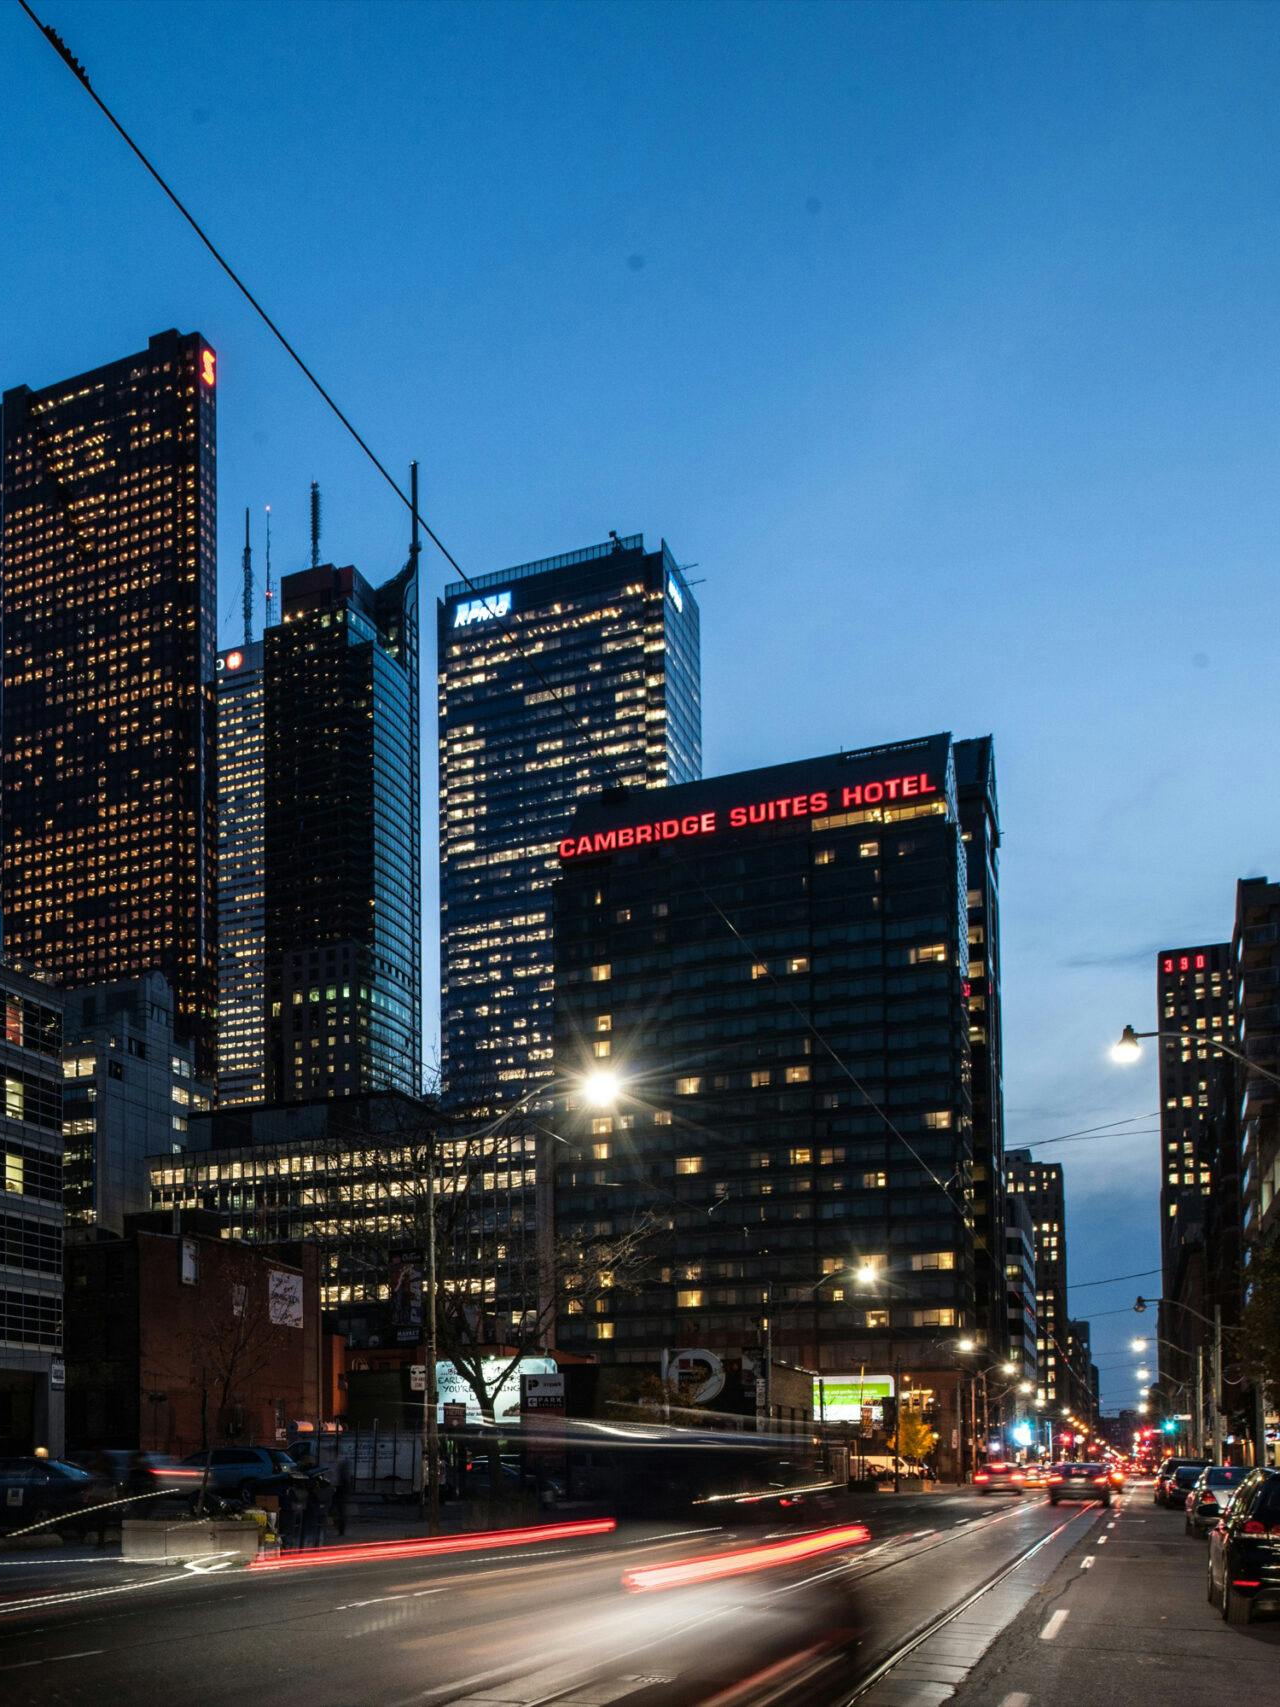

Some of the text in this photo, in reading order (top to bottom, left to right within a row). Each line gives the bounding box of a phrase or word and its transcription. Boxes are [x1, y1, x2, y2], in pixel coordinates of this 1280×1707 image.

[558, 773, 937, 860] CAMBRIDGE SUITES HOTEL
